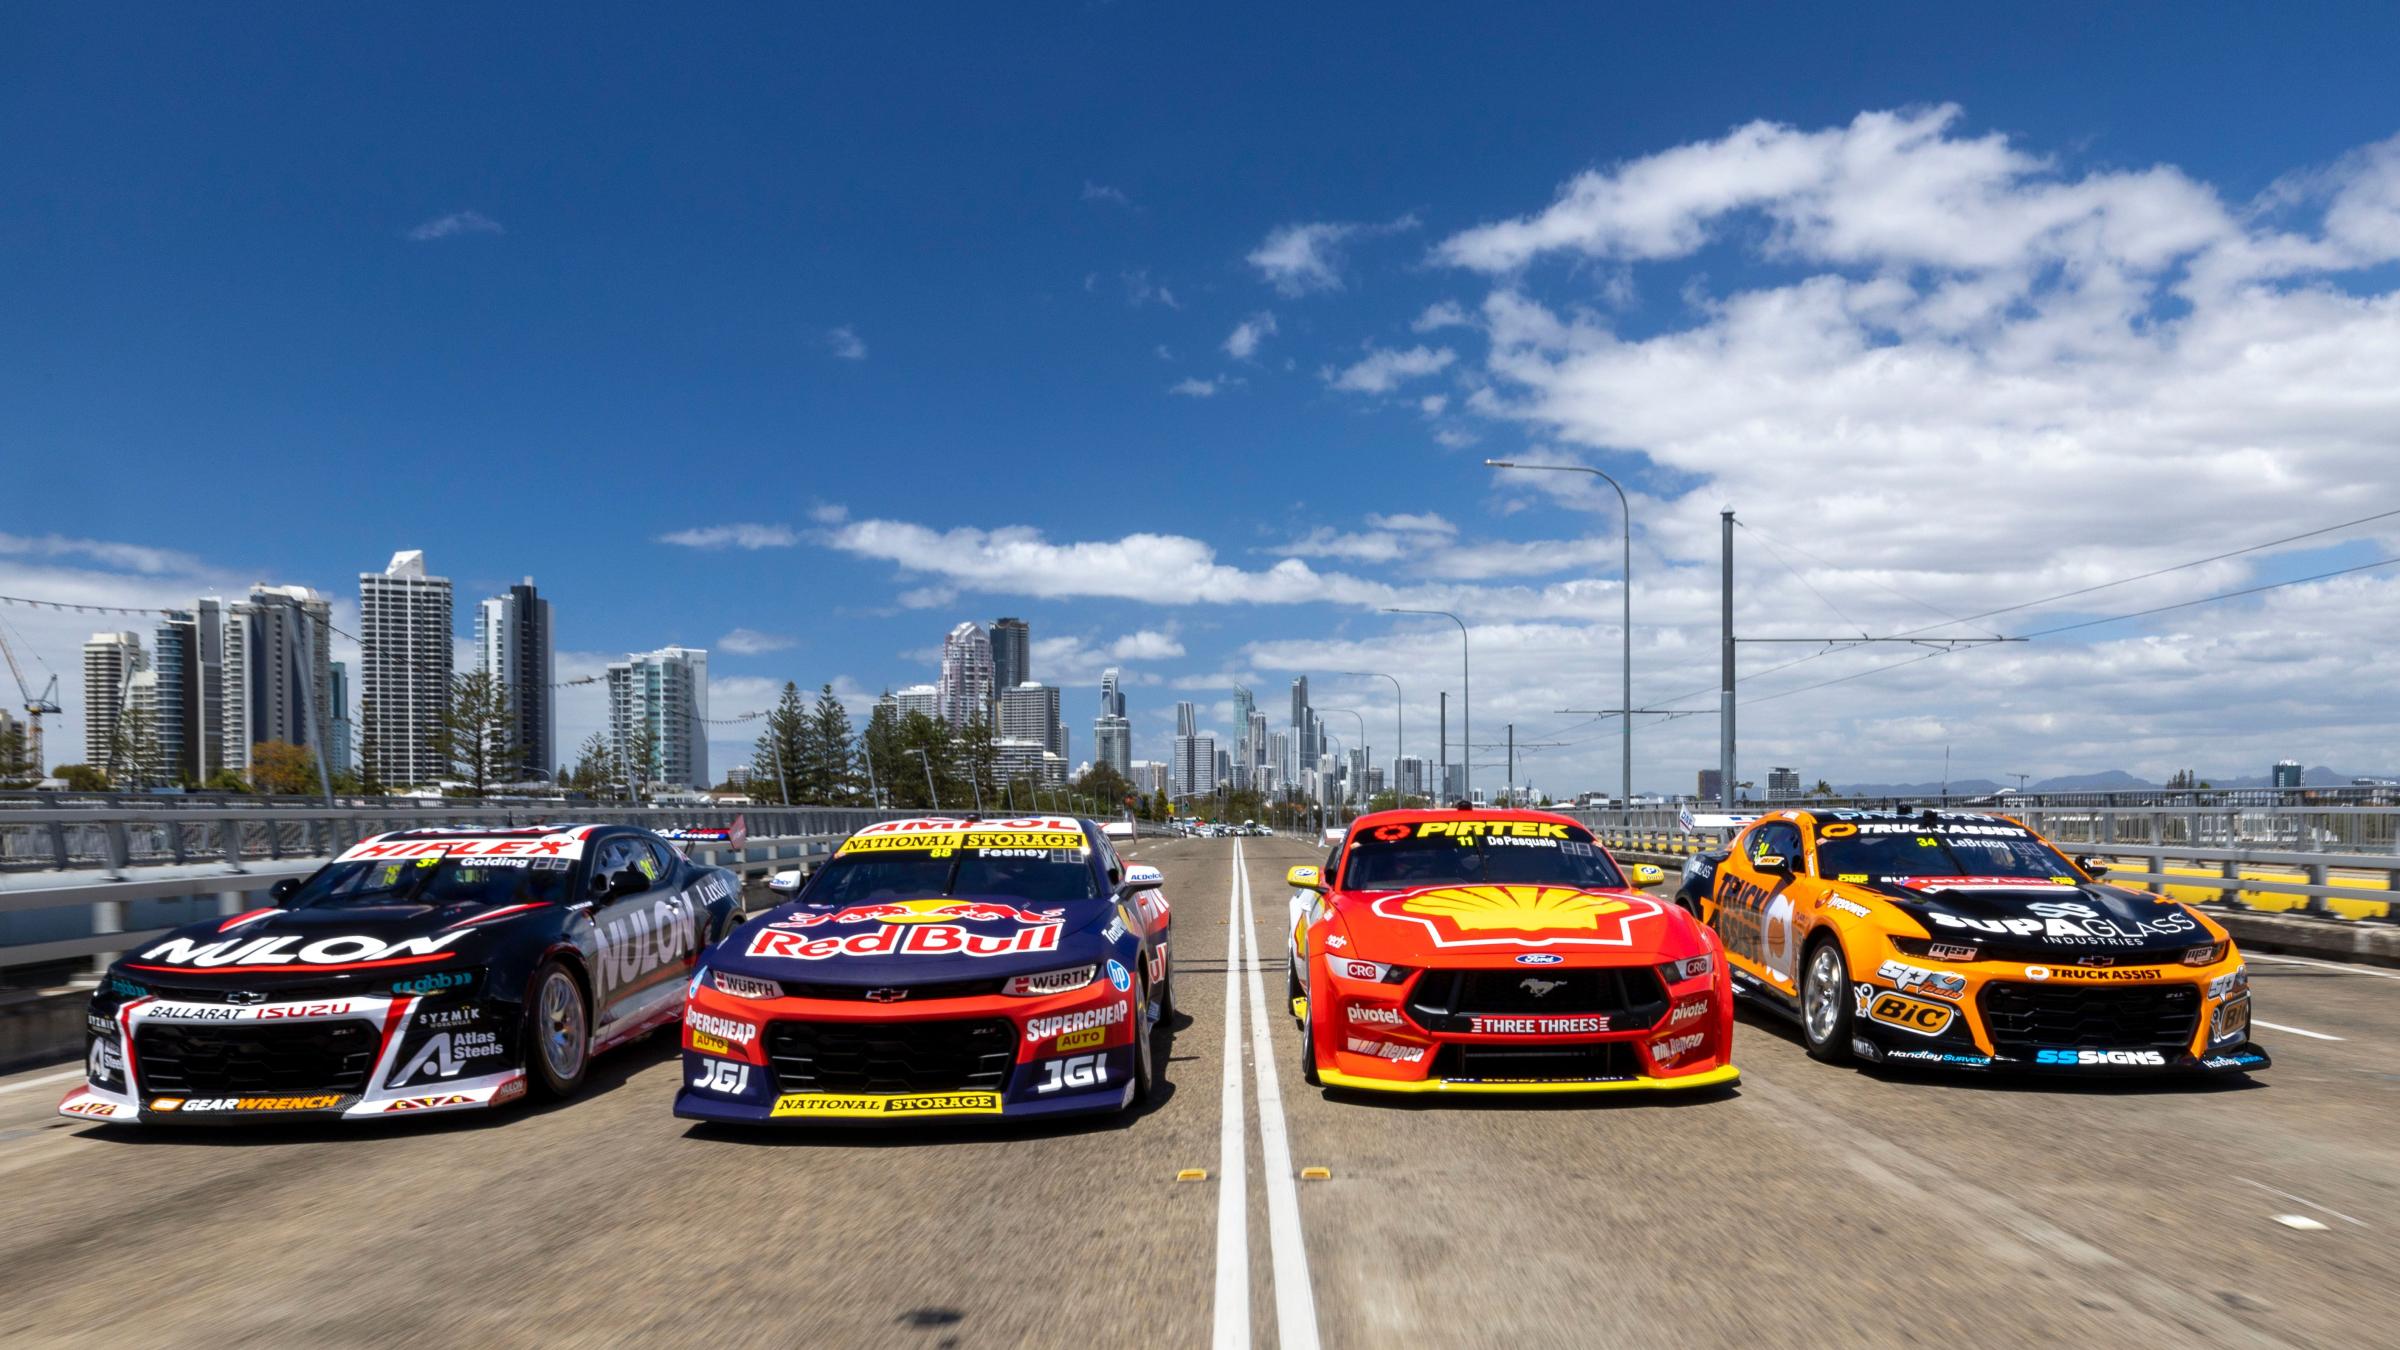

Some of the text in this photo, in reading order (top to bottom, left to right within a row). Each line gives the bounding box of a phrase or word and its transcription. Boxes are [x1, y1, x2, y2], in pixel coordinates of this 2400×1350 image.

[1416, 821, 1569, 839] PIRTEK
[1858, 824, 2027, 837] TRUCK ASSIST
[846, 833, 1078, 850] NATIONAL STORAGE
[1457, 836, 1474, 846] 11
[1916, 837, 1937, 847] 34
[1946, 838, 2010, 850] LeBrocq
[350, 841, 572, 858] HIFLEX
[930, 848, 952, 858] 88
[979, 848, 1048, 859] Feeney
[460, 857, 529, 869] Golding
[1716, 872, 1769, 912] TRUCK
[141, 928, 478, 967] NULON
[594, 890, 695, 1001] NULON
[747, 923, 1063, 960] Red Bull
[2042, 936, 2145, 946] INDUSTRIES
[1524, 954, 1555, 964] Ford
[1348, 964, 1375, 977] CRC
[1687, 961, 1707, 974] CRC
[2050, 968, 2162, 980] TRUCK ASSIST
[1109, 960, 1127, 991] hp
[147, 1006, 246, 1020] BALLARAT
[256, 1003, 351, 1019] ISUZU
[1026, 1000, 1128, 1042] SUPERCHEAP
[1484, 1018, 1599, 1033] THREE THREES
[454, 1032, 496, 1046] Atlas
[697, 1035, 724, 1049] AUTO
[1062, 1032, 1100, 1046] AUTO
[454, 1043, 503, 1059] Steels
[693, 1058, 750, 1095] JGI
[1037, 1053, 1108, 1094] JGI
[182, 1095, 340, 1111] GEARWRENCH
[778, 1096, 992, 1110] NATIONAL STORAGE
